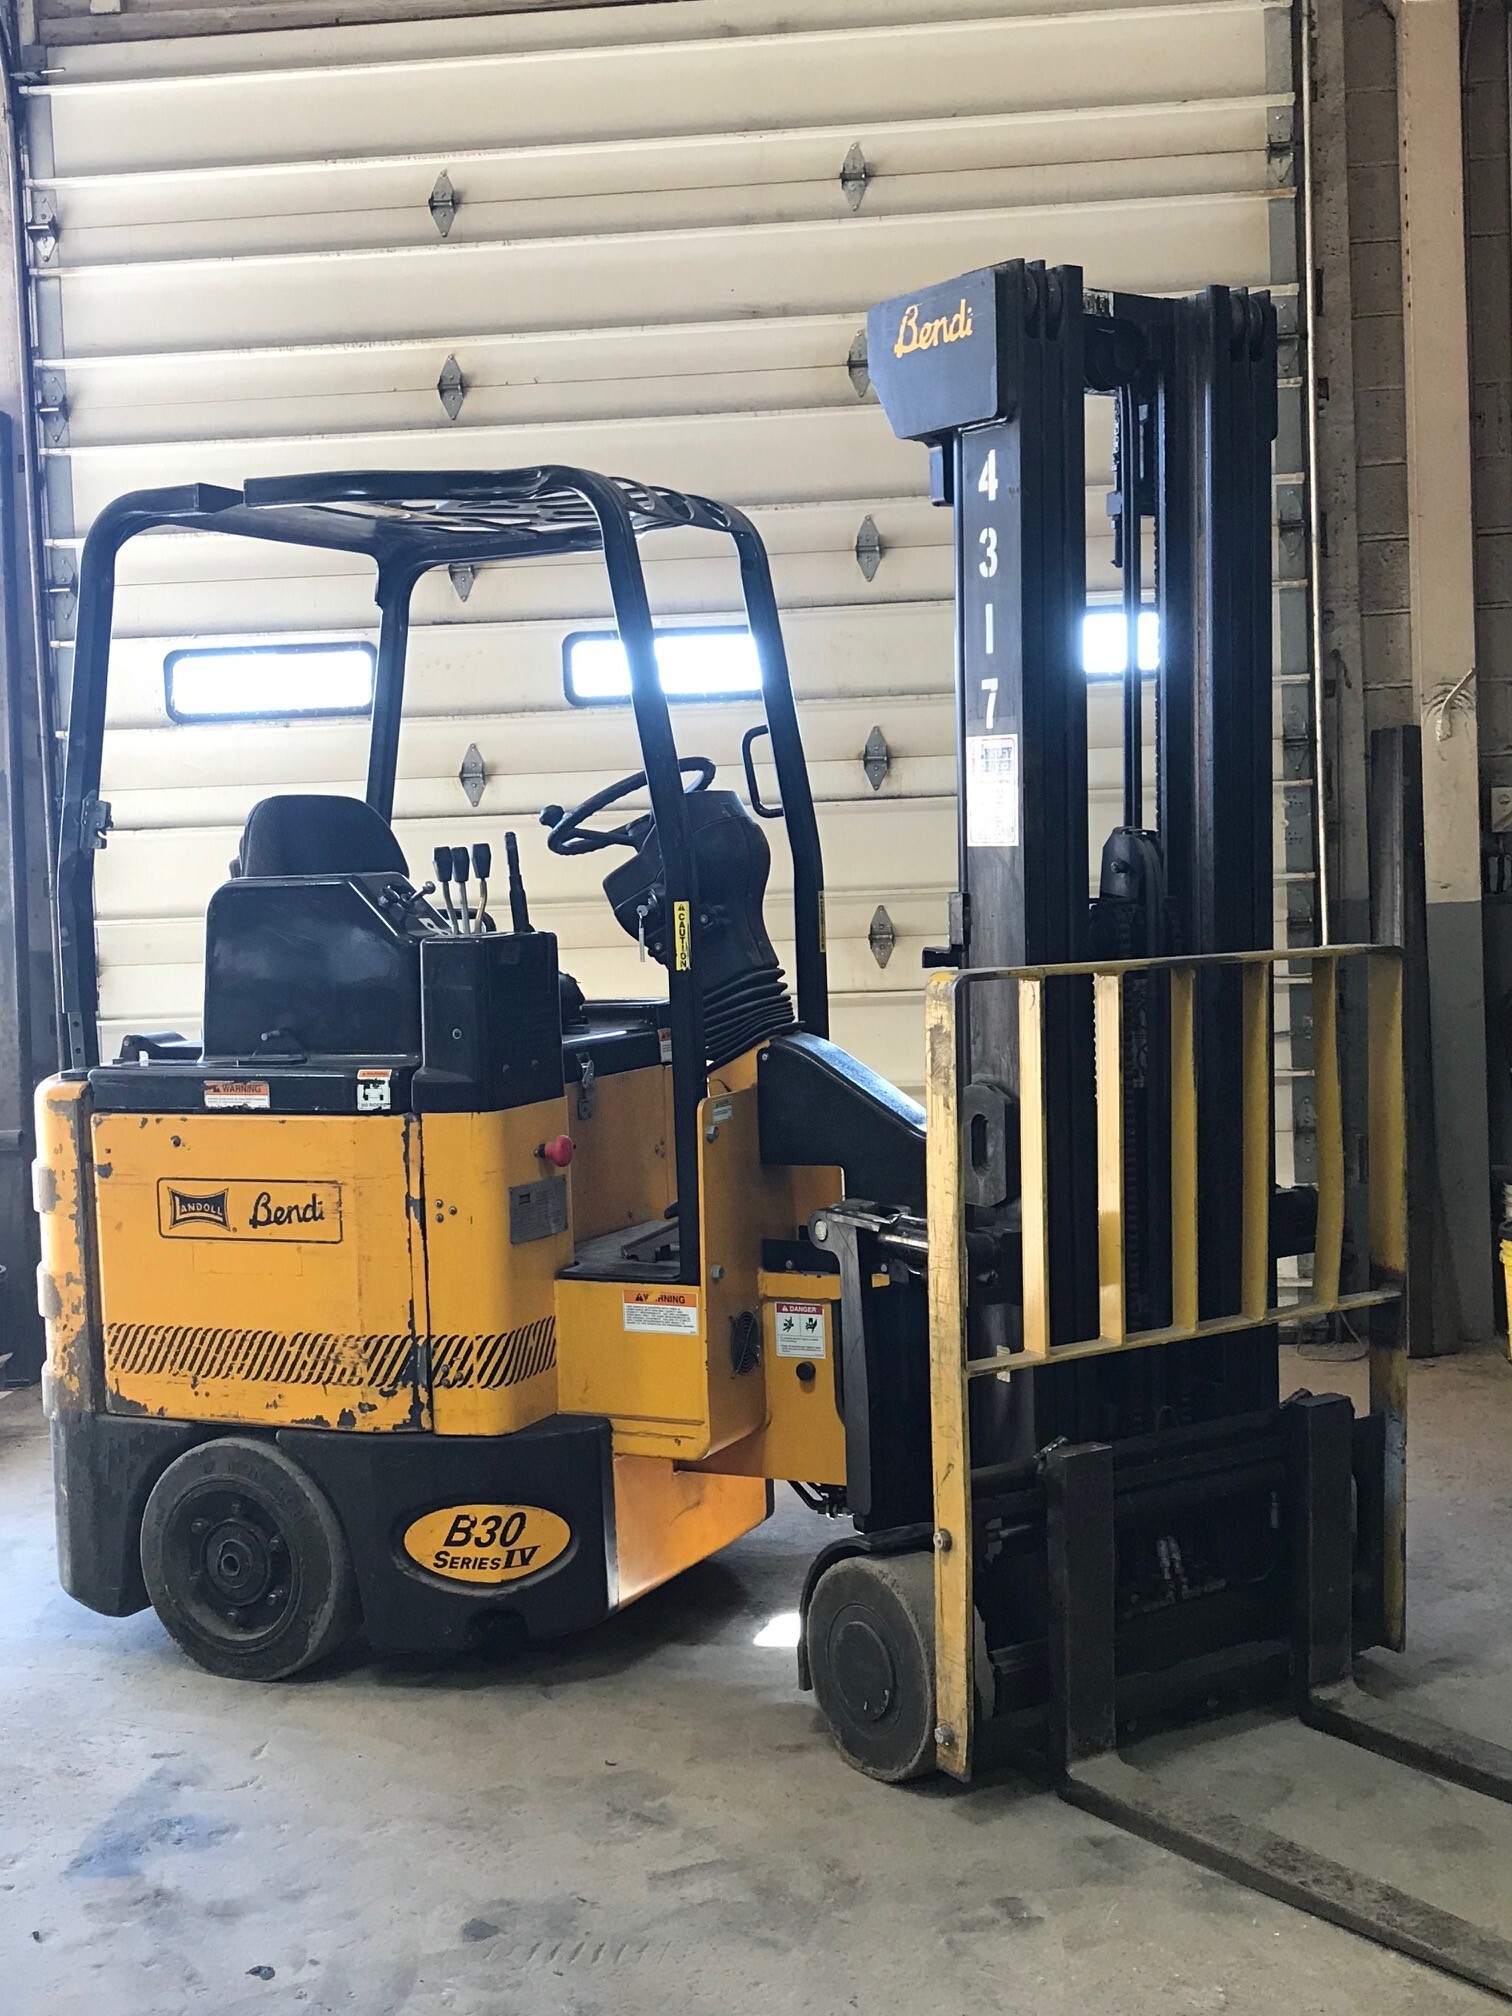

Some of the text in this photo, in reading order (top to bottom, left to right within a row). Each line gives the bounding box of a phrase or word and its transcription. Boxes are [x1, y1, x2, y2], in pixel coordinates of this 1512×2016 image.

[893, 298, 973, 358] Bendi
[678, 912, 687, 967] CAUTION
[222, 1084, 262, 1094] WARNING
[174, 1192, 325, 1229] LANDOLL Bendi
[789, 1305, 817, 1313] DANGER
[443, 1511, 527, 1548] B30
[433, 1545, 541, 1570] SERIES IV
